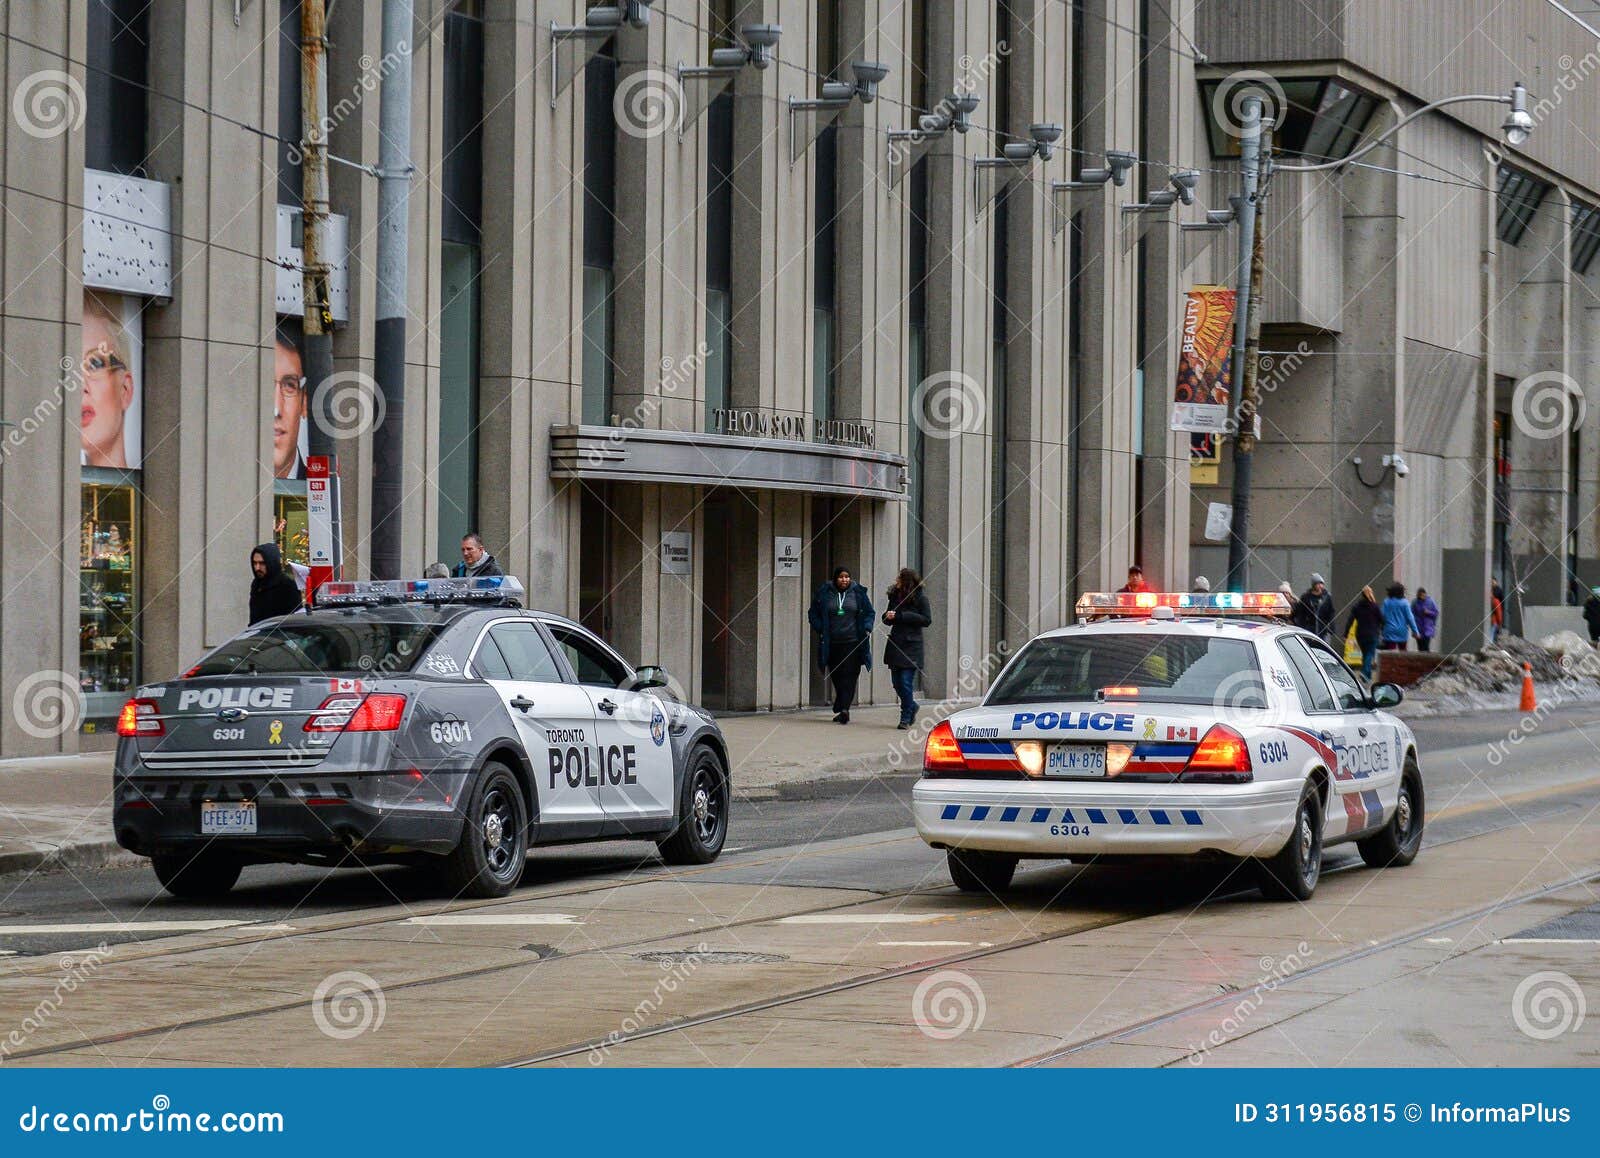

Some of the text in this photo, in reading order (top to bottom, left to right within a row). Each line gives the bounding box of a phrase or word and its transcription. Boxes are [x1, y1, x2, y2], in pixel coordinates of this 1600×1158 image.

[1182, 298, 1201, 353] BEAUTY
[712, 407, 875, 447] THOMSON BUILDING
[784, 545, 792, 556] 65
[1276, 674, 1294, 688] 911
[177, 687, 295, 711] POLICE
[430, 721, 473, 744] 6301
[966, 725, 999, 738] TORONTO
[1011, 711, 1136, 732] POLICE
[212, 728, 245, 741] 6301
[545, 728, 585, 743] TORONTO
[1259, 739, 1289, 764] 6304
[1335, 741, 1389, 776] POLICE
[547, 744, 637, 789] POLICE
[1050, 824, 1090, 836] 6304
